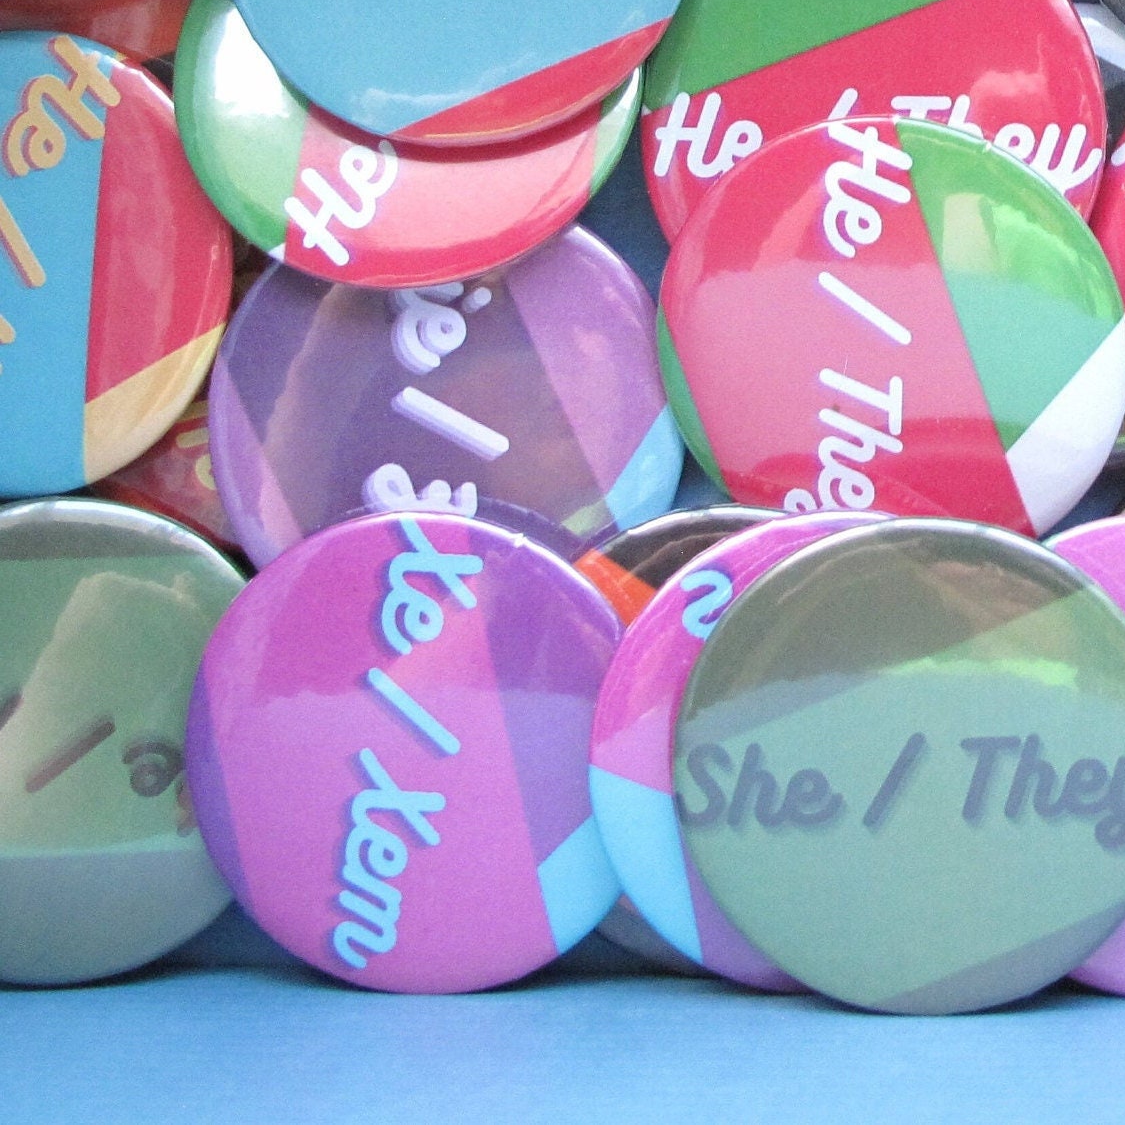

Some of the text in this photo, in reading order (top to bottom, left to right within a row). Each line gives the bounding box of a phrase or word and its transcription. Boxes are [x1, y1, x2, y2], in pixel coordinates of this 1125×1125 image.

[3, 35, 122, 176] He
[653, 91, 764, 178] He
[284, 139, 398, 266] He
[823, 125, 914, 259] He
[369, 517, 484, 656] Xe
[677, 743, 844, 833] She
[330, 748, 447, 970] Xem
